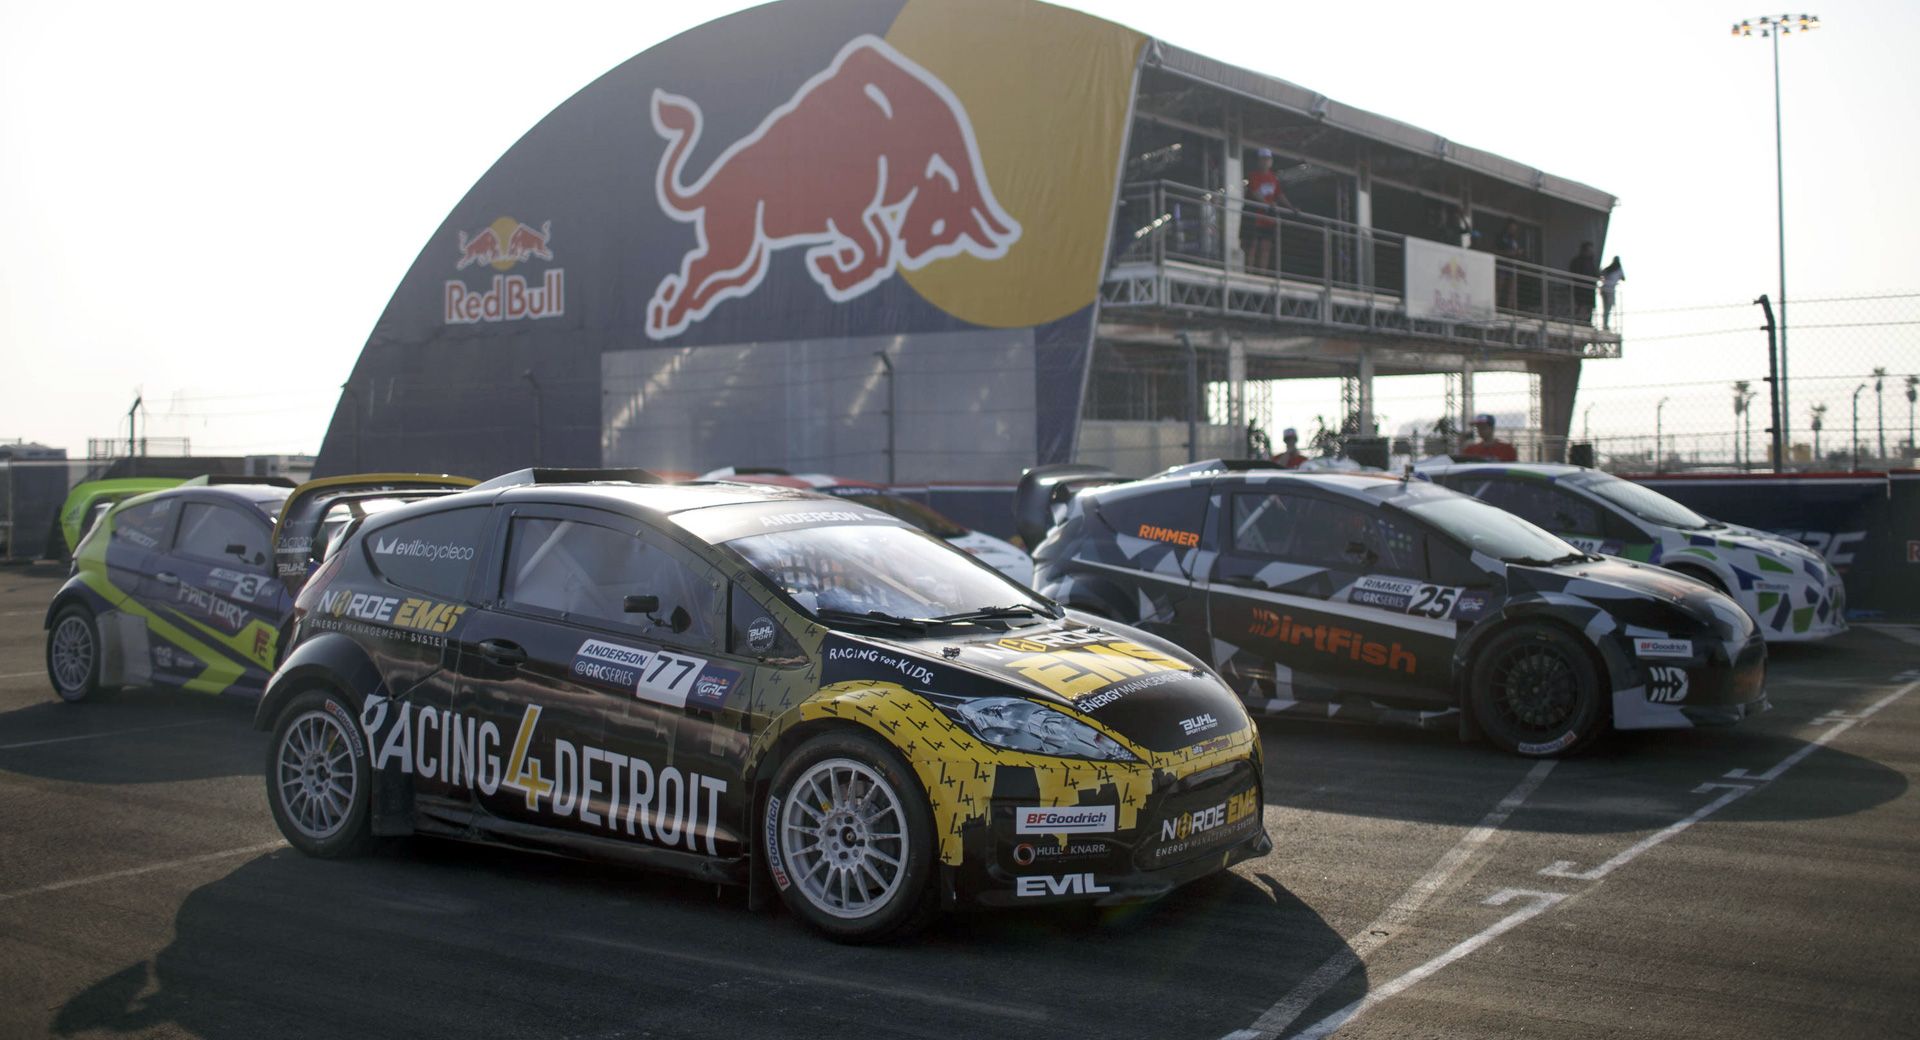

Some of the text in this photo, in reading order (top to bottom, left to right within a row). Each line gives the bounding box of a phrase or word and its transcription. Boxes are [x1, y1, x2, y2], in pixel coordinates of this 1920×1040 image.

[445, 268, 564, 324] Red Bull
[760, 511, 863, 527] ANDERSON
[1138, 524, 1199, 548] RIMMER
[396, 539, 474, 561] evilbicycleco
[241, 575, 258, 598] 3
[1363, 579, 1412, 594] RIMMER
[178, 581, 249, 628] FACTORY
[393, 597, 467, 633] EMS
[1407, 586, 1455, 619] 25
[311, 618, 343, 631] ENERGY
[344, 622, 408, 641] MANAGEMENT
[1249, 607, 1417, 673] DirtFish
[583, 644, 648, 666] ANDERSON
[829, 648, 877, 662] RACING
[896, 659, 934, 686] KIDS
[575, 660, 634, 687] @GRCSERIES
[646, 654, 696, 690] 77
[1004, 643, 1193, 700] EMS
[1078, 687, 1123, 713] ENERGY
[1179, 713, 1217, 730] BUHL
[361, 694, 728, 855] RACING 4 DETROIT
[1026, 812, 1107, 825] BFGoodrich
[767, 799, 788, 887] BFGoodrich
[1037, 844, 1106, 856] HULL KNARR
[1156, 842, 1189, 857] ENERGY
[1016, 873, 1110, 897] EVIL
